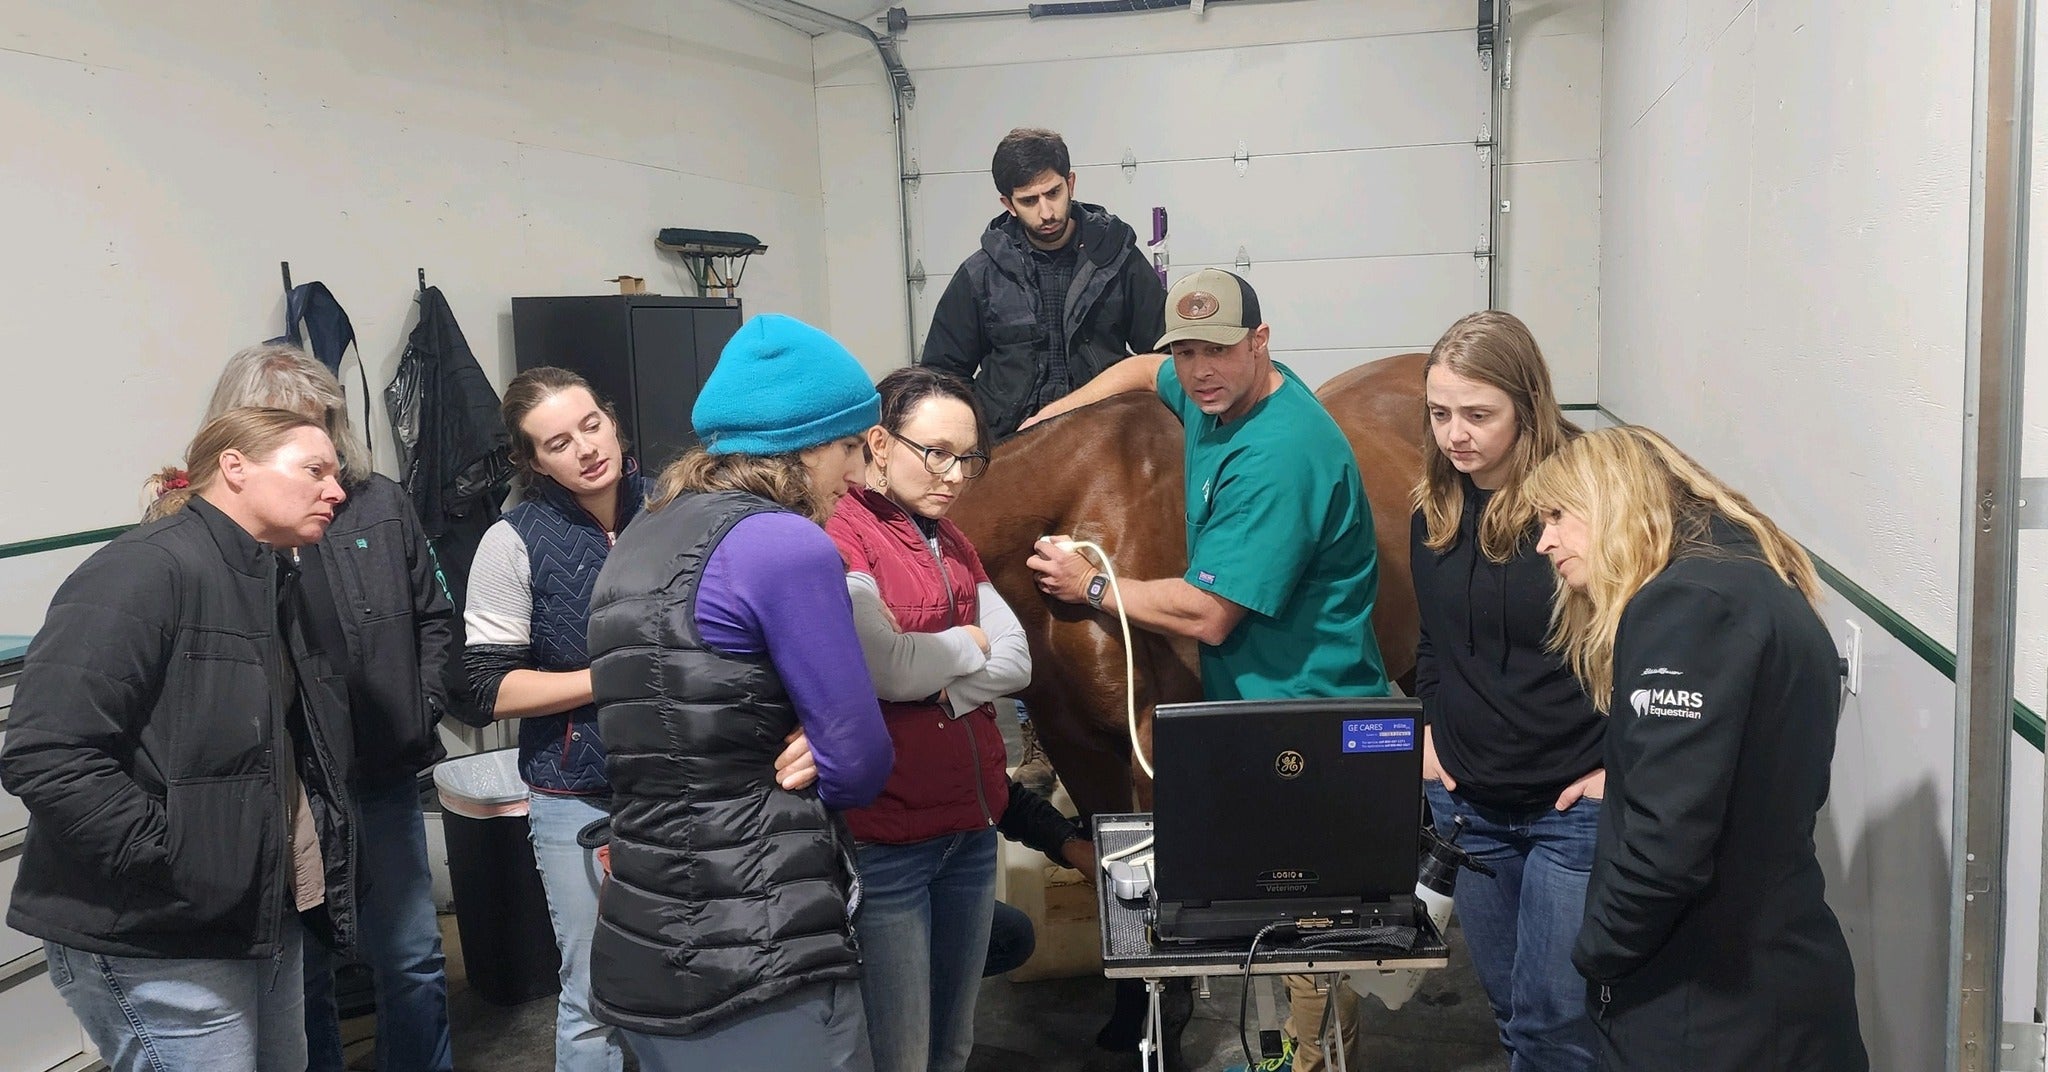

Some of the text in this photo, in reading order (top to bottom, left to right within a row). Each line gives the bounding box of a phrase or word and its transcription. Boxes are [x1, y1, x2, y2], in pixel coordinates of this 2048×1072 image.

[1651, 688, 1703, 708] MARS
[1649, 705, 1702, 720] Equestrian
[1347, 723, 1383, 732] GE CARES
[1272, 871, 1297, 879] LOGIQ
[1266, 884, 1308, 892] Veterinary
